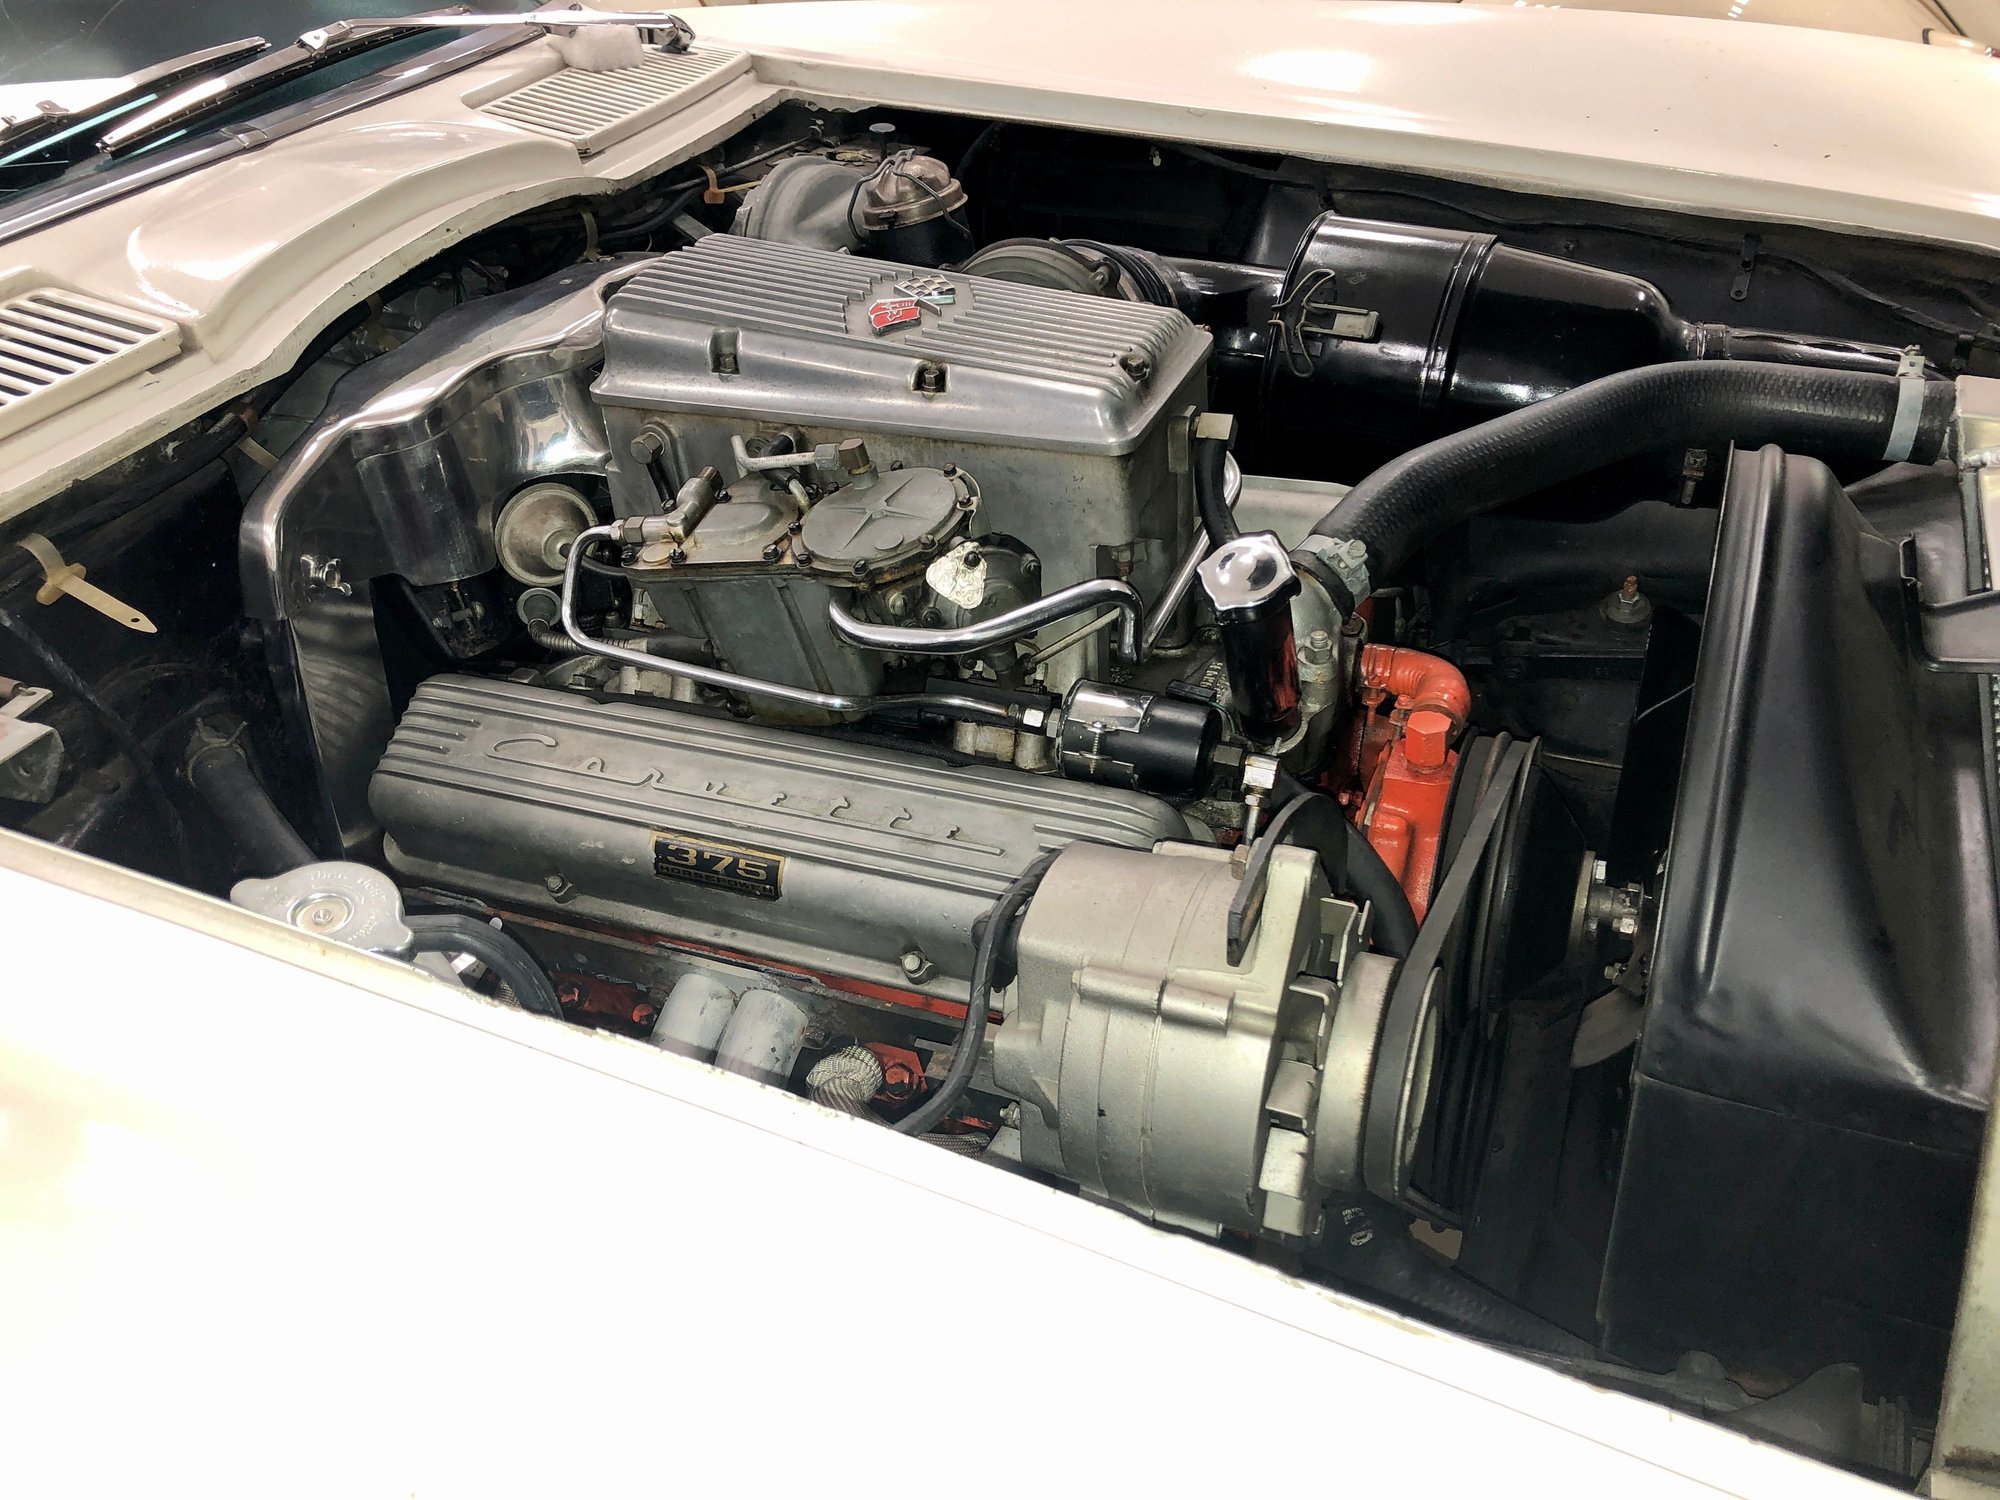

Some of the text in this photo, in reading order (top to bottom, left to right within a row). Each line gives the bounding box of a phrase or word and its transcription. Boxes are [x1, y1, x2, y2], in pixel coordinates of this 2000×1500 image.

[484, 734, 1005, 856] Corvette
[659, 864, 773, 894] HORSEPOWER
[666, 844, 768, 880] 375
